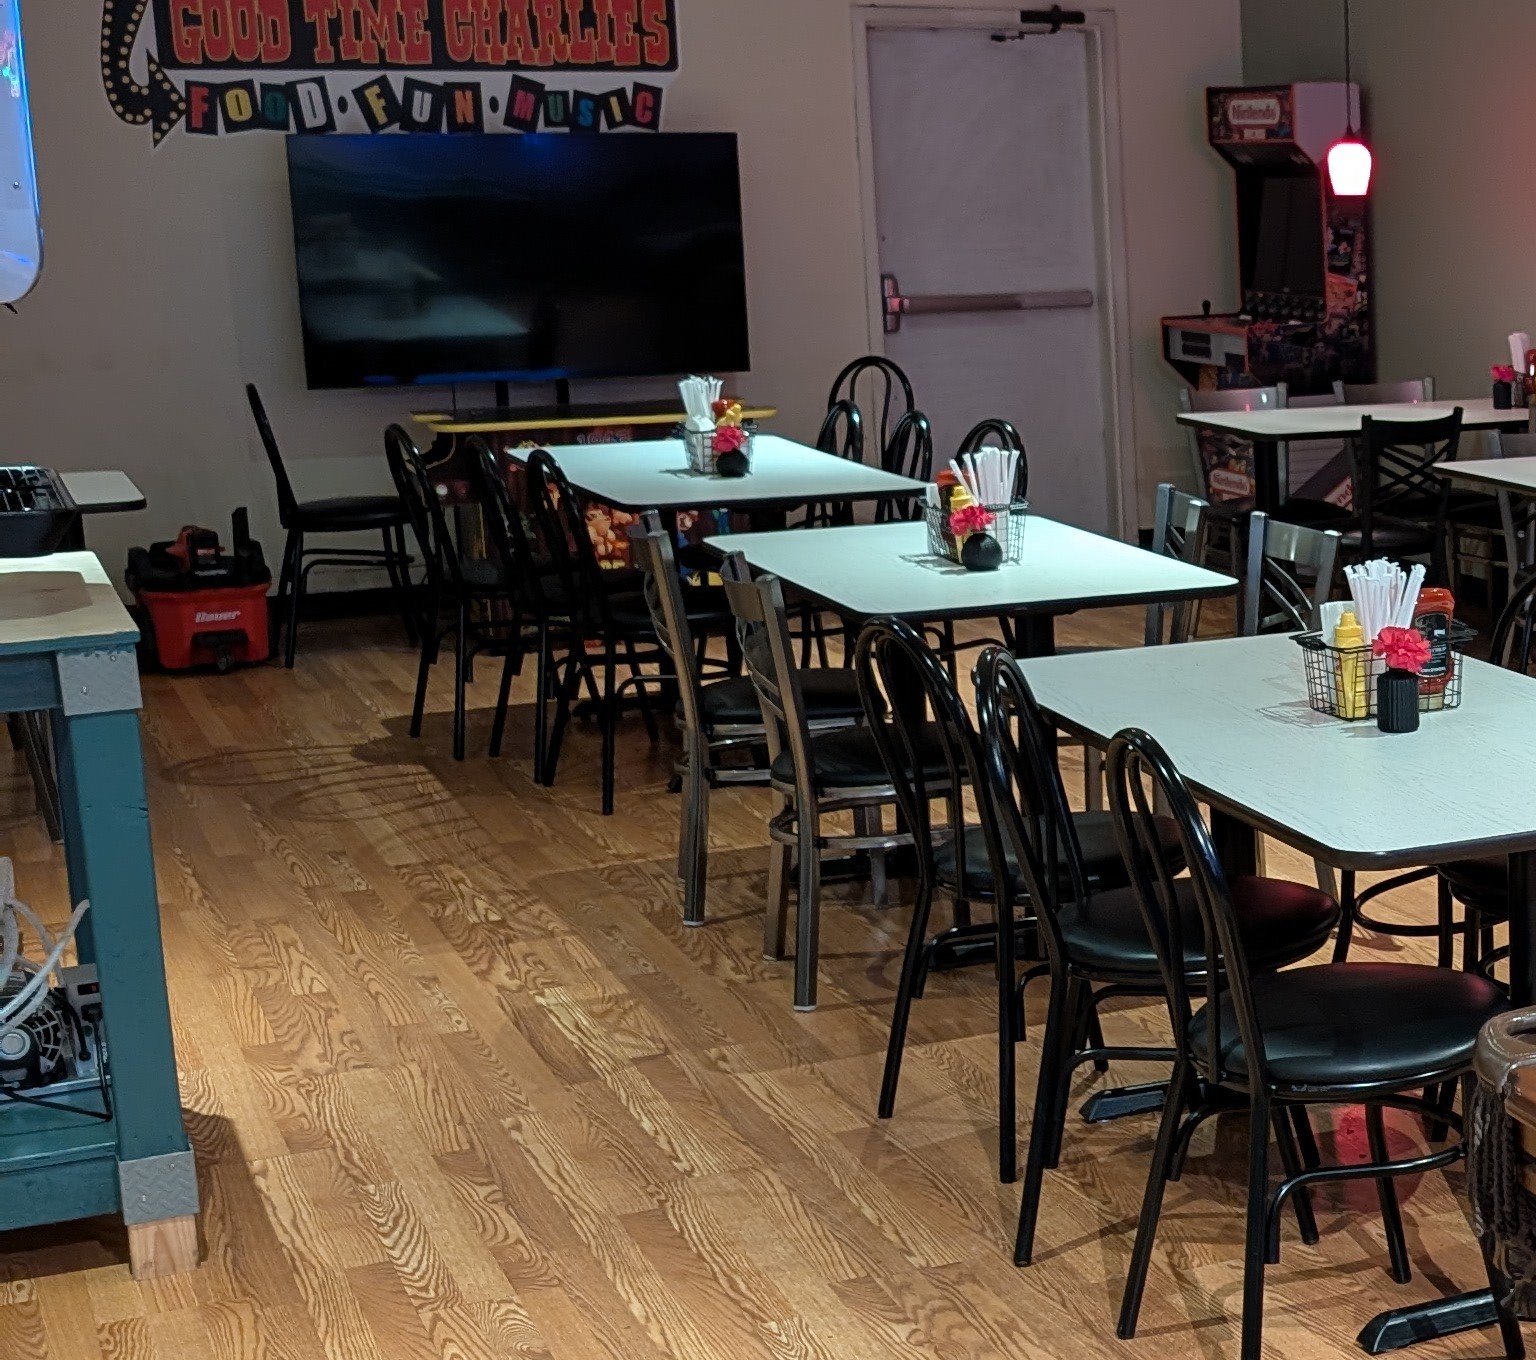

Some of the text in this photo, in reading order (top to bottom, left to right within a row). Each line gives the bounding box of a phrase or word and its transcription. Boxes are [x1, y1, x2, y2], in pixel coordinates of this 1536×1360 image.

[190, 82, 655, 128] FOOD FUN MUSIC
